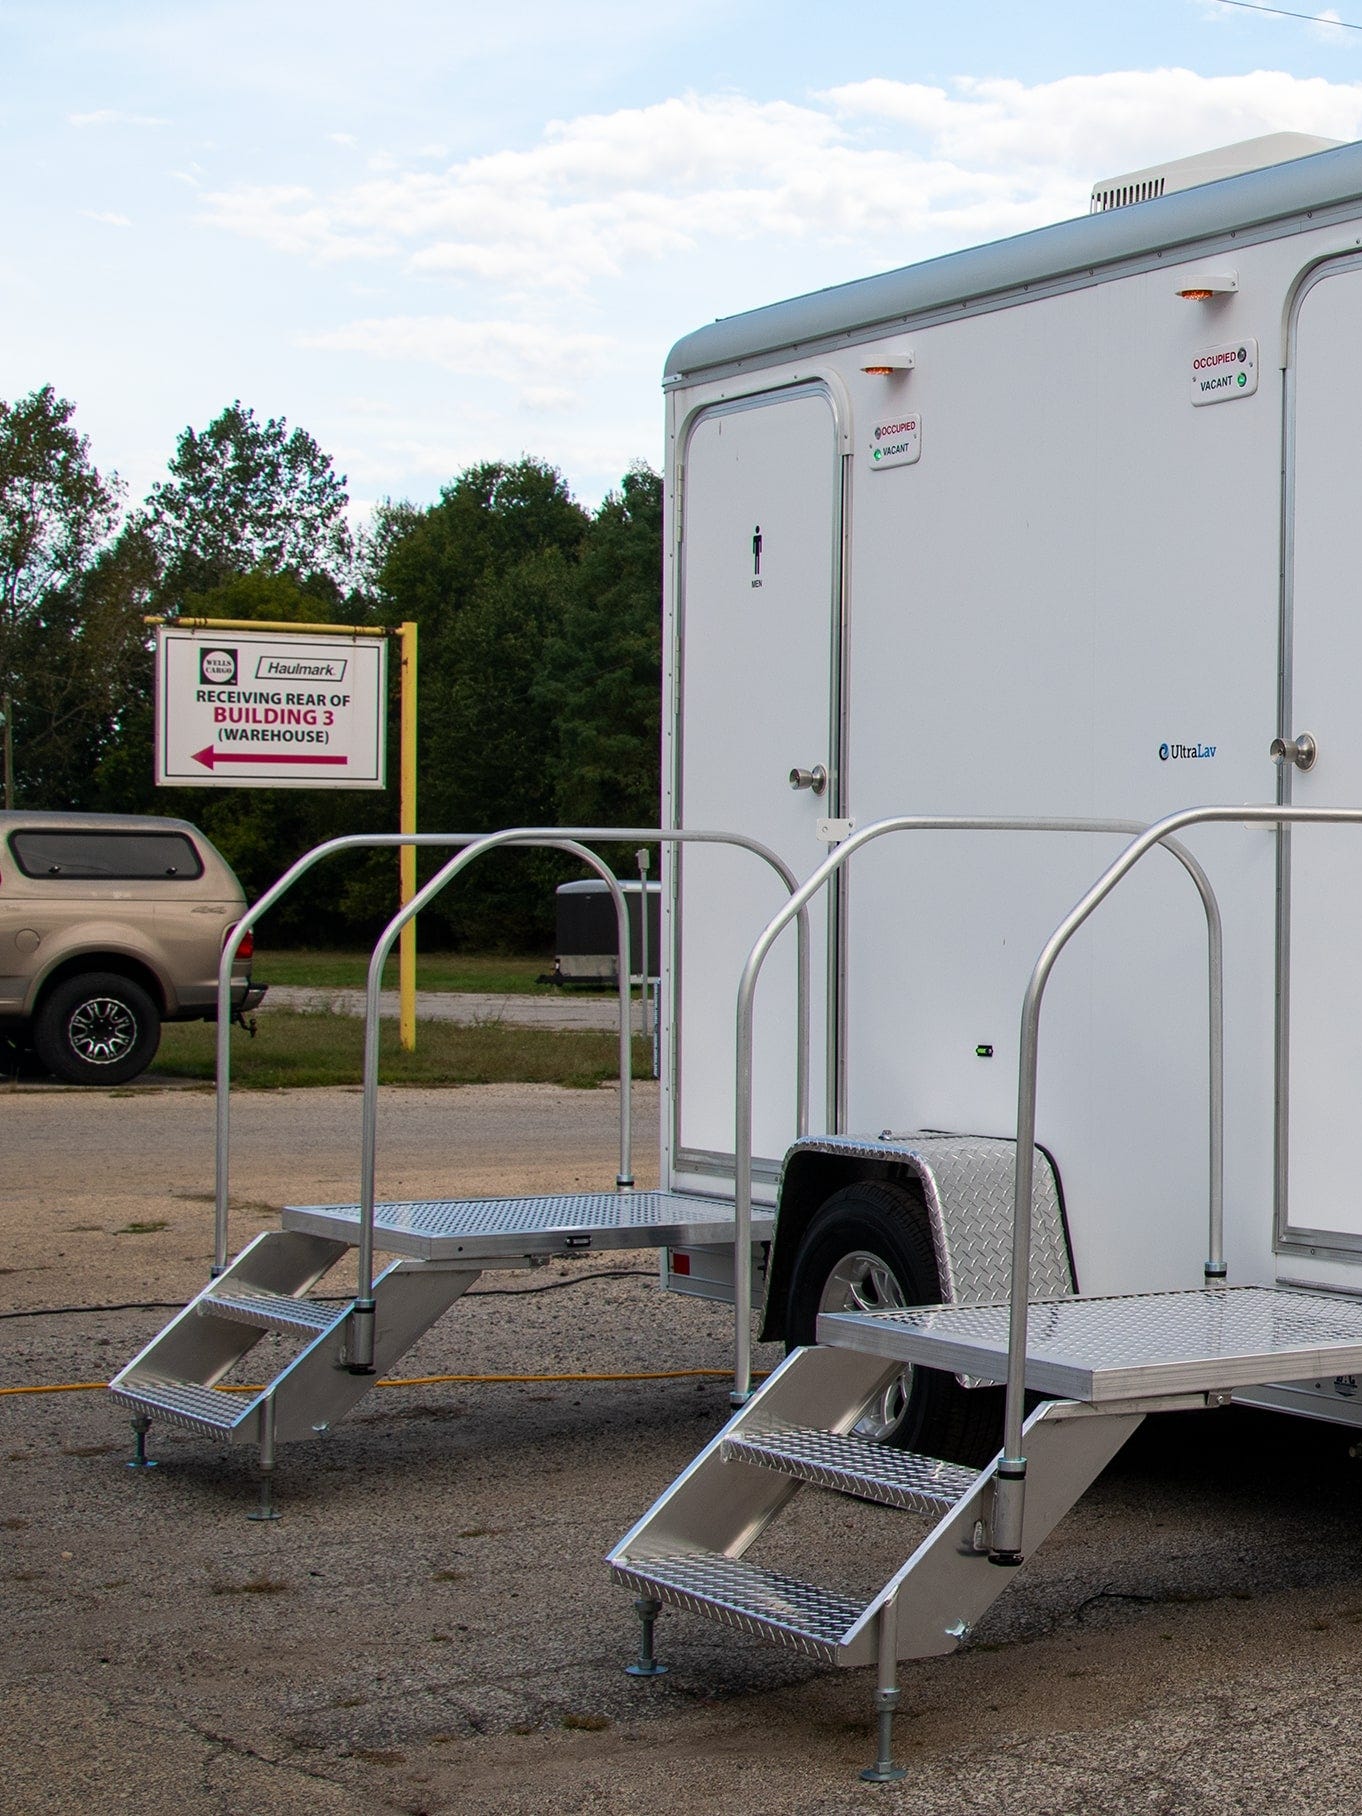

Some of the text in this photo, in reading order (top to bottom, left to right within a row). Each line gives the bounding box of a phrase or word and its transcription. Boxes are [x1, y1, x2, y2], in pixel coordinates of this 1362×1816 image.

[1193, 351, 1237, 370] OCCUPIED
[1200, 375, 1233, 391] VACANT
[881, 421, 916, 436] OCCUPIED
[882, 443, 909, 456] VACANT
[751, 579, 763, 588] MEN
[268, 662, 334, 676] Haulmark
[196, 690, 351, 707] RECEIVING REAR OF
[213, 706, 334, 726] BUILDING 3
[218, 728, 329, 745] (WAREHOUSE)
[1171, 743, 1217, 759] UltraLav
